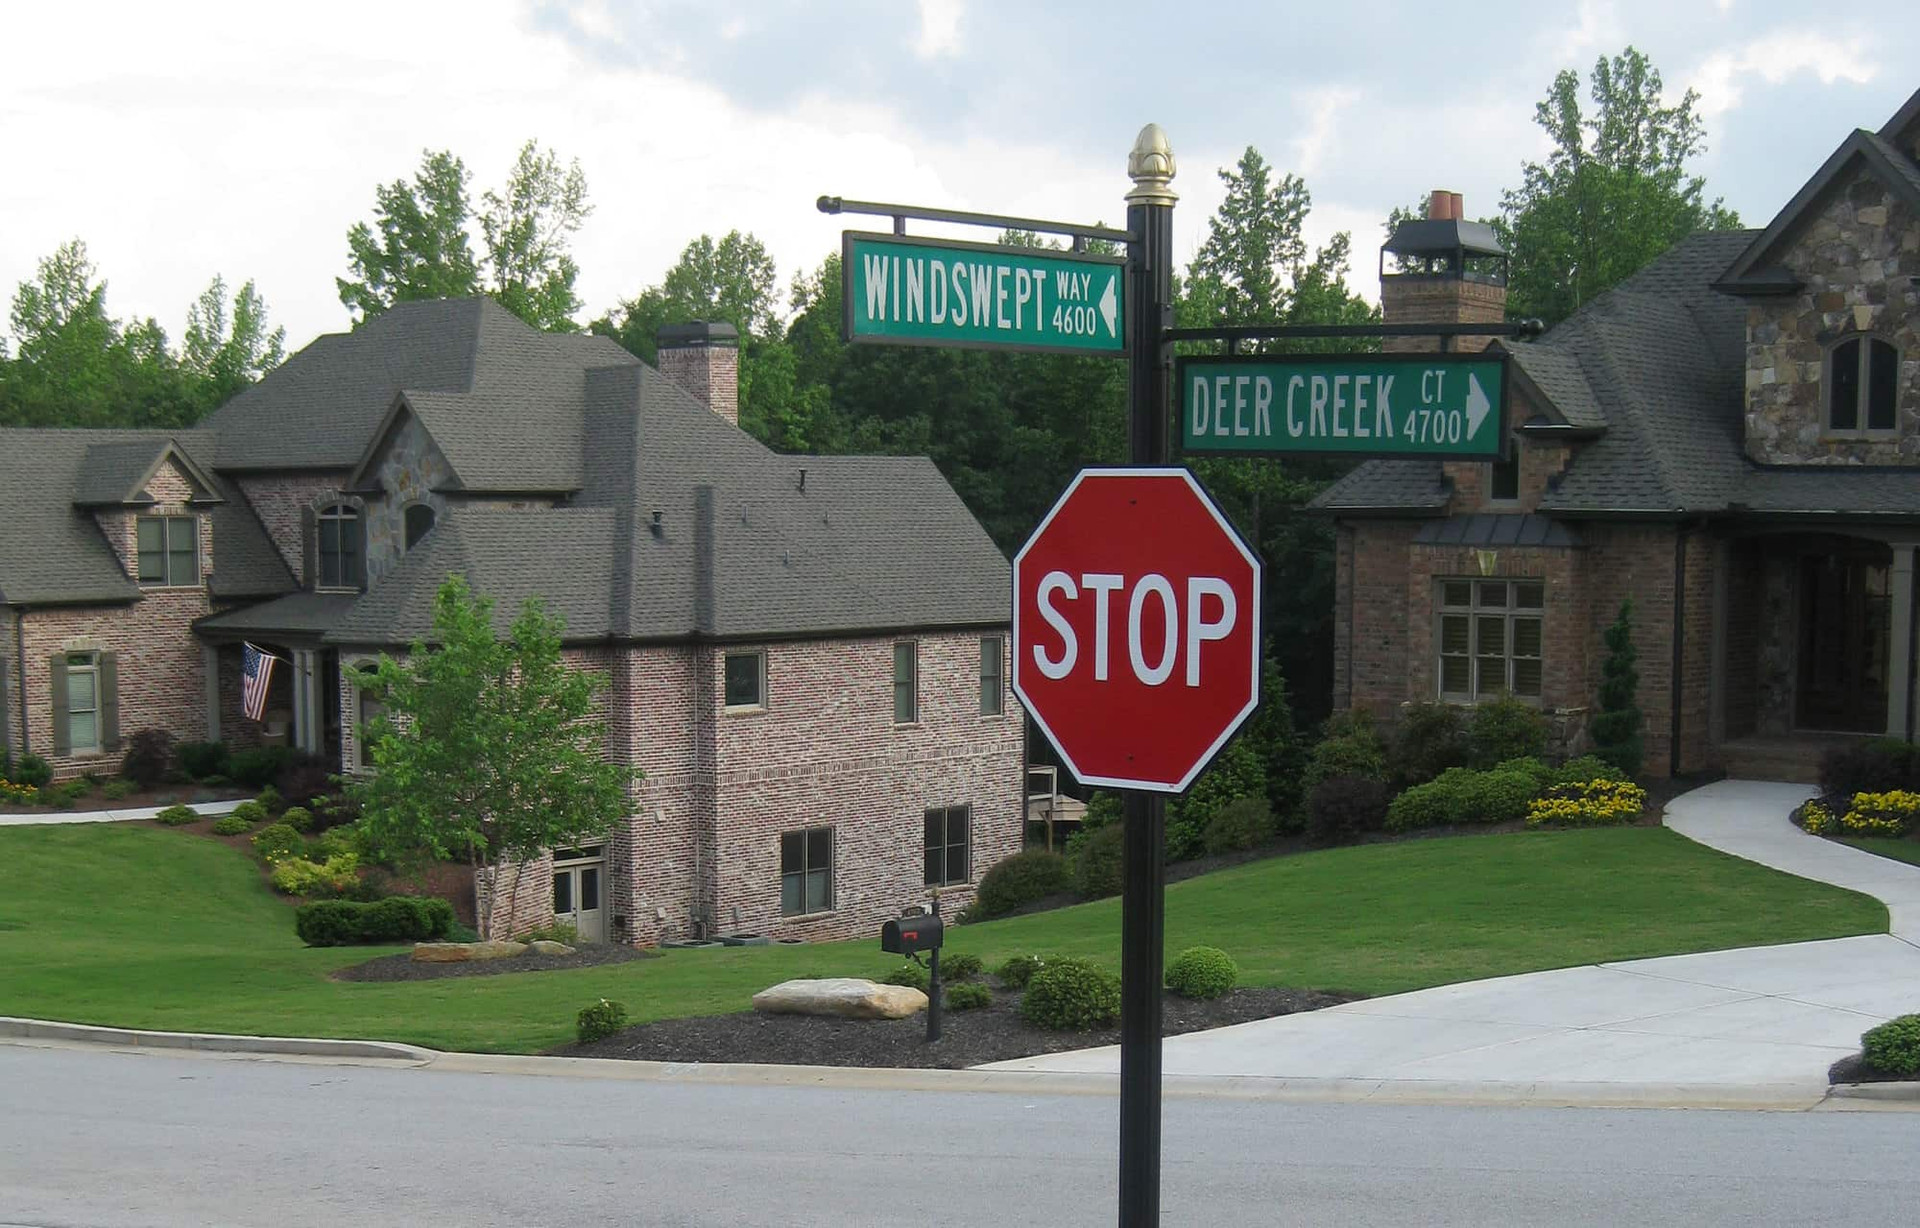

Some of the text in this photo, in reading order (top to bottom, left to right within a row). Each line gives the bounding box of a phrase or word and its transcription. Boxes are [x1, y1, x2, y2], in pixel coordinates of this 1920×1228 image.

[863, 253, 1092, 331] WINDSWEPT WAY
[1052, 305, 1097, 336] 4600
[1192, 370, 1447, 438] DEER CREEK CT
[1403, 409, 1462, 444] 4700
[1033, 570, 1237, 687] STOP
